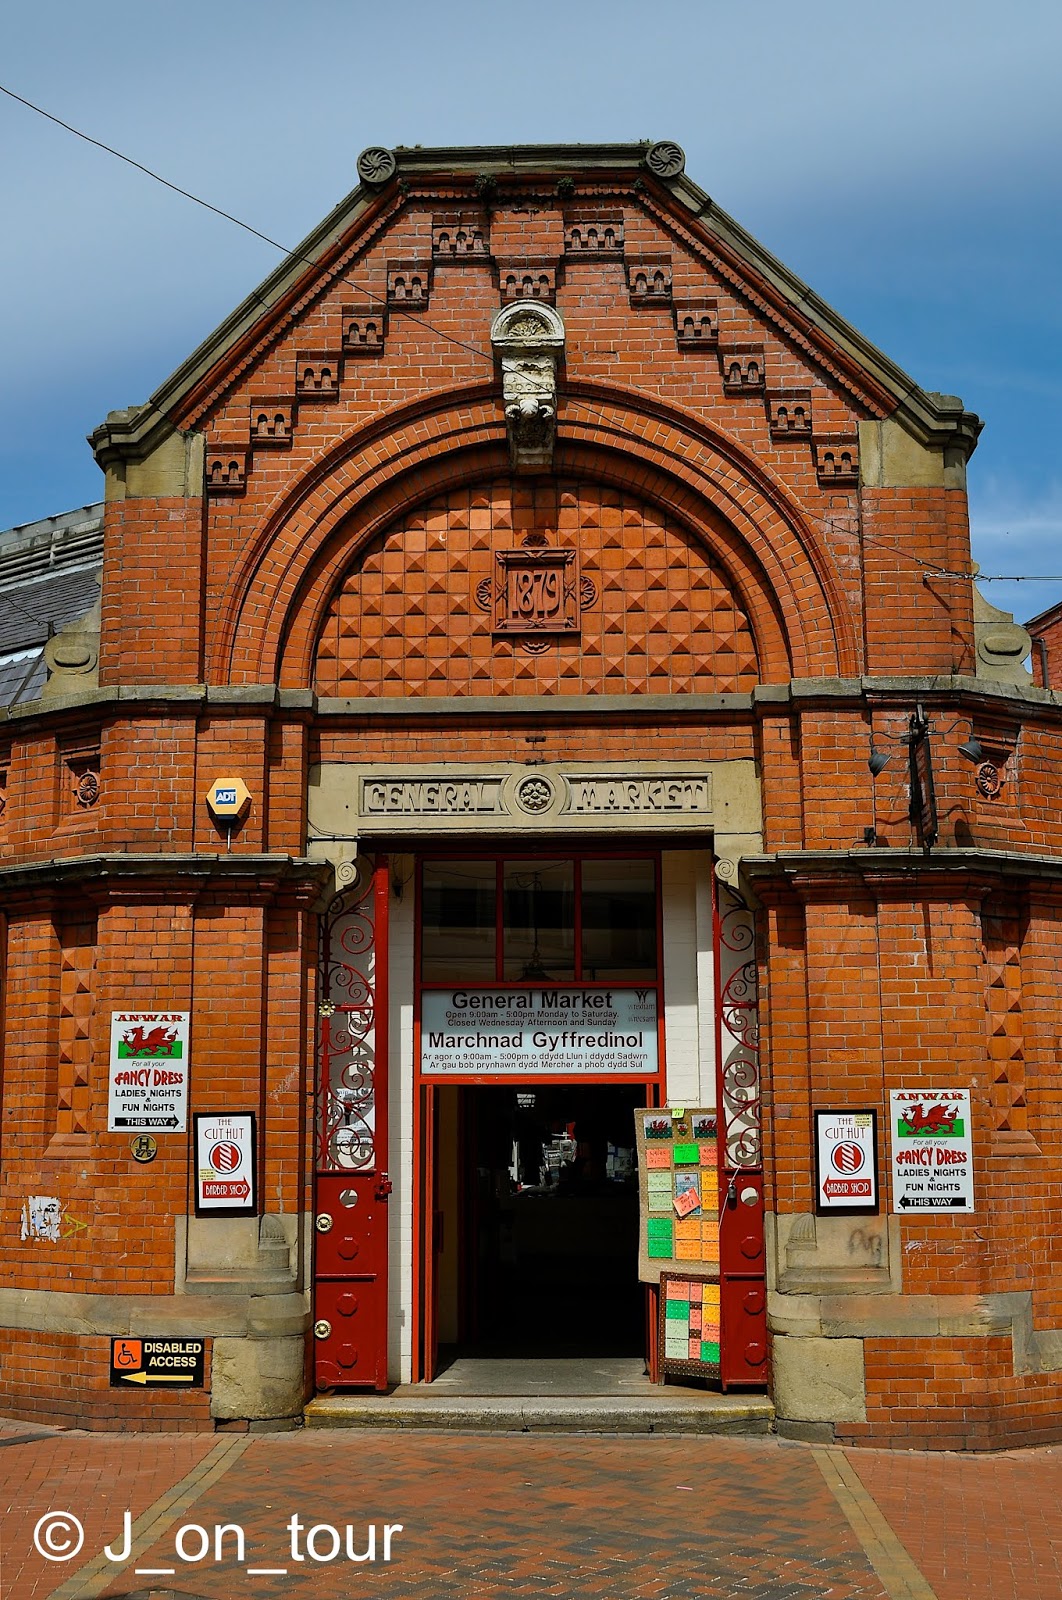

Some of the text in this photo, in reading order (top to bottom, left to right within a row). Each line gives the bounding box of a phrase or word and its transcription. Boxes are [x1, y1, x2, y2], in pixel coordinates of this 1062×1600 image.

[508, 570, 560, 619] 1879
[216, 791, 237, 802] ADT
[368, 780, 706, 812] GENERAL MARKET
[452, 991, 613, 1009] General Market
[116, 1014, 184, 1022] ANWAR
[445, 1010, 467, 1019] Open
[469, 1010, 498, 1018] 9:00am
[506, 1010, 535, 1019] 5:00pm
[537, 1010, 569, 1019] Monday
[571, 1010, 580, 1018] to
[581, 1010, 619, 1019] Saturday.
[447, 1018, 617, 1028] Closed Wednesday Afternoon and Sunday
[429, 1031, 643, 1052] Marchnad Gyffredinol
[434, 1053, 453, 1062] agor
[499, 1053, 529, 1062] 5:00pm
[539, 1052, 564, 1061] ddydd
[566, 1052, 583, 1060] Llun
[589, 1052, 615, 1061] ddydd
[617, 1052, 648, 1060] Sadwrn
[151, 1061, 166, 1069] your
[429, 1061, 439, 1069] Ar
[441, 1062, 457, 1070] gau
[458, 1061, 475, 1069] bob
[476, 1061, 516, 1070] prynhawn
[518, 1061, 539, 1070] dydd
[584, 1061, 605, 1070] phob
[607, 1061, 628, 1070] dydd
[114, 1069, 184, 1087] FANCY DRESS
[895, 1092, 964, 1101] ANWAR
[143, 1104, 175, 1112] NIGHTS
[126, 1118, 169, 1126] THIS WAY
[217, 1118, 232, 1126] THE
[837, 1117, 853, 1125] THE
[204, 1127, 245, 1140] CUT HUT
[825, 1127, 866, 1139] CUT HUT
[138, 1137, 150, 1150] H
[896, 1147, 967, 1166] FANCY DRESS
[897, 1168, 967, 1177] LADIES NIGHTS
[205, 1184, 248, 1196] BARBER SHOP
[826, 1182, 870, 1194] BARBER SHOP
[908, 1198, 953, 1206] THIS WAY
[144, 1342, 202, 1354] DISABLED
[148, 1356, 197, 1367] ACCESS
